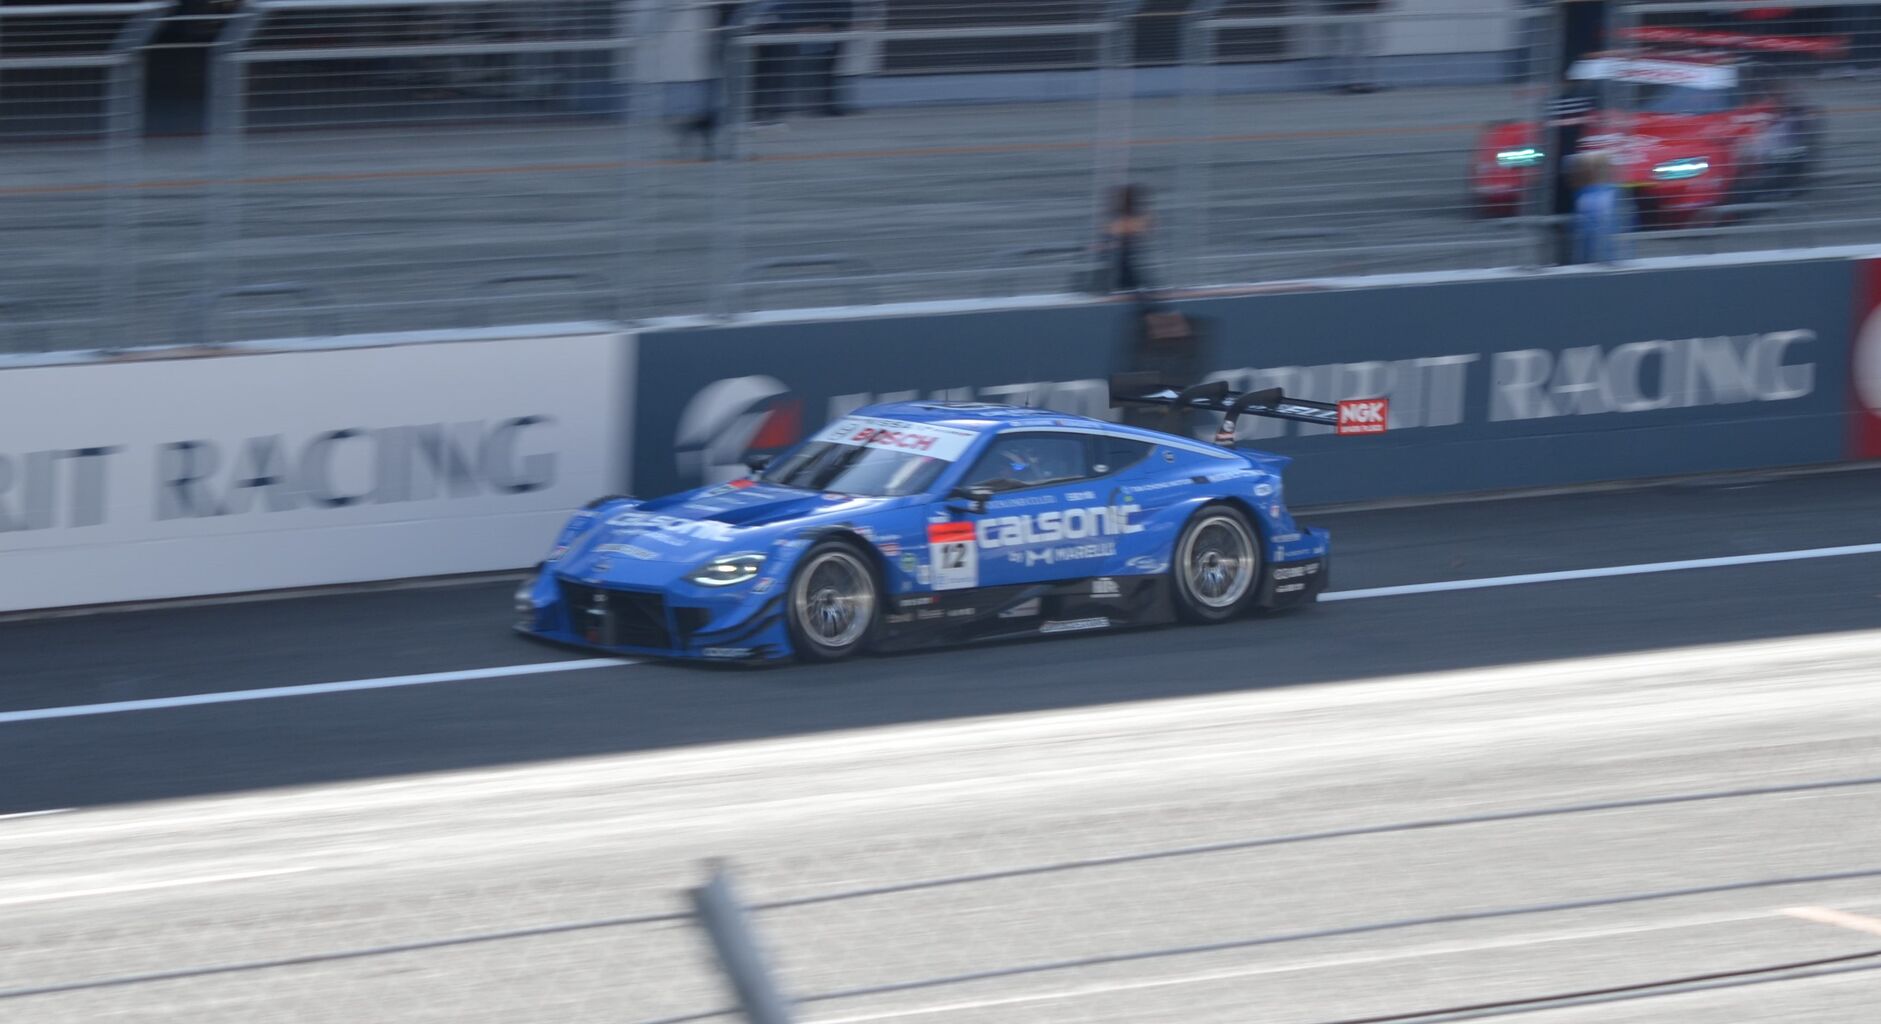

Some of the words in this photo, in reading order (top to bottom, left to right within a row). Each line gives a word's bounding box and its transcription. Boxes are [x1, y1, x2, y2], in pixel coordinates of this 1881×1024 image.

[1488, 329, 1817, 422] RACING
[1341, 403, 1384, 424] NGK
[851, 427, 940, 452] BOSCH
[154, 415, 558, 521] RACING
[941, 542, 967, 568] 12
[1055, 543, 1116, 562] MARELLI
